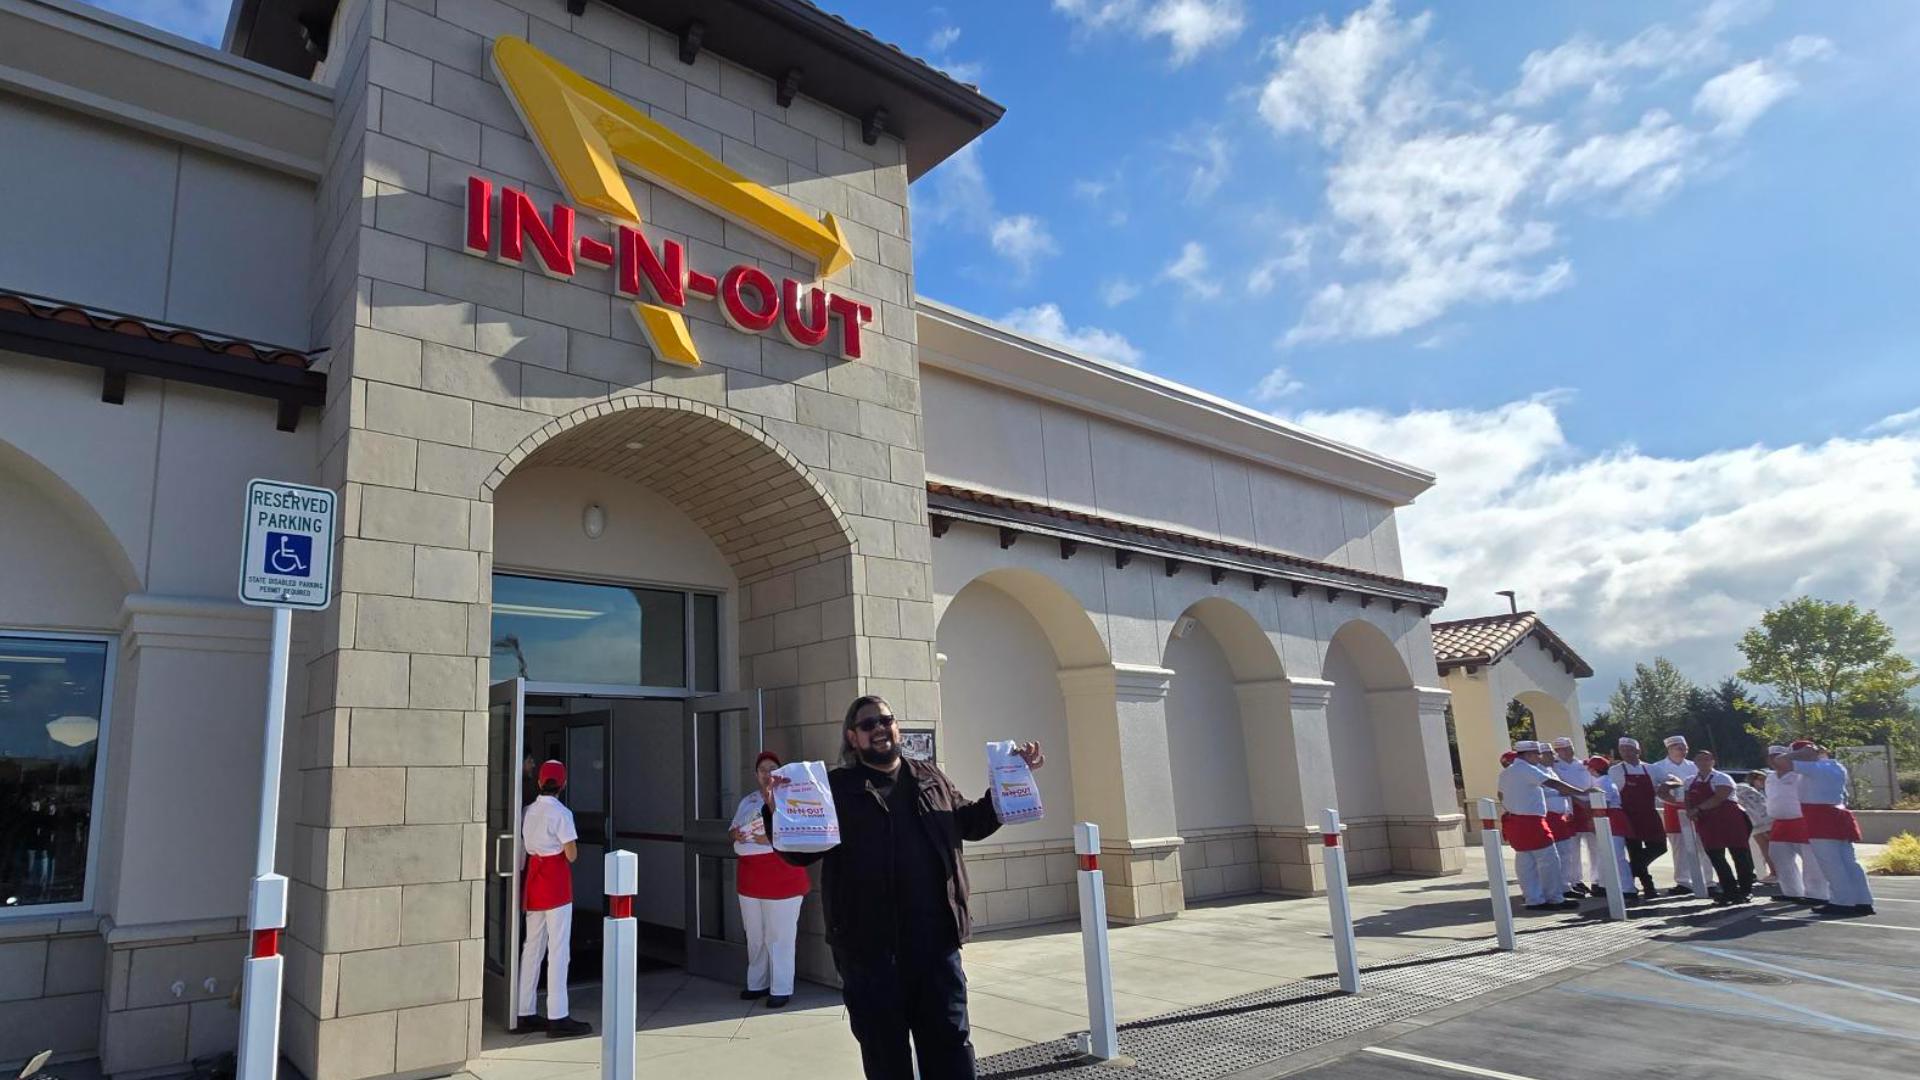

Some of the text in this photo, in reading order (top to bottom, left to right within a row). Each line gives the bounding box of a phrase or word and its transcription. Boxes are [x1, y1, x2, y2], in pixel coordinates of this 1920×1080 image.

[464, 175, 873, 360] IN-N-OUT
[254, 490, 328, 514] RESERVED
[258, 511, 322, 533] PARKING
[248, 576, 324, 589] STATE DISABLED PARKING
[259, 586, 311, 597] PERMIT REQUIRED
